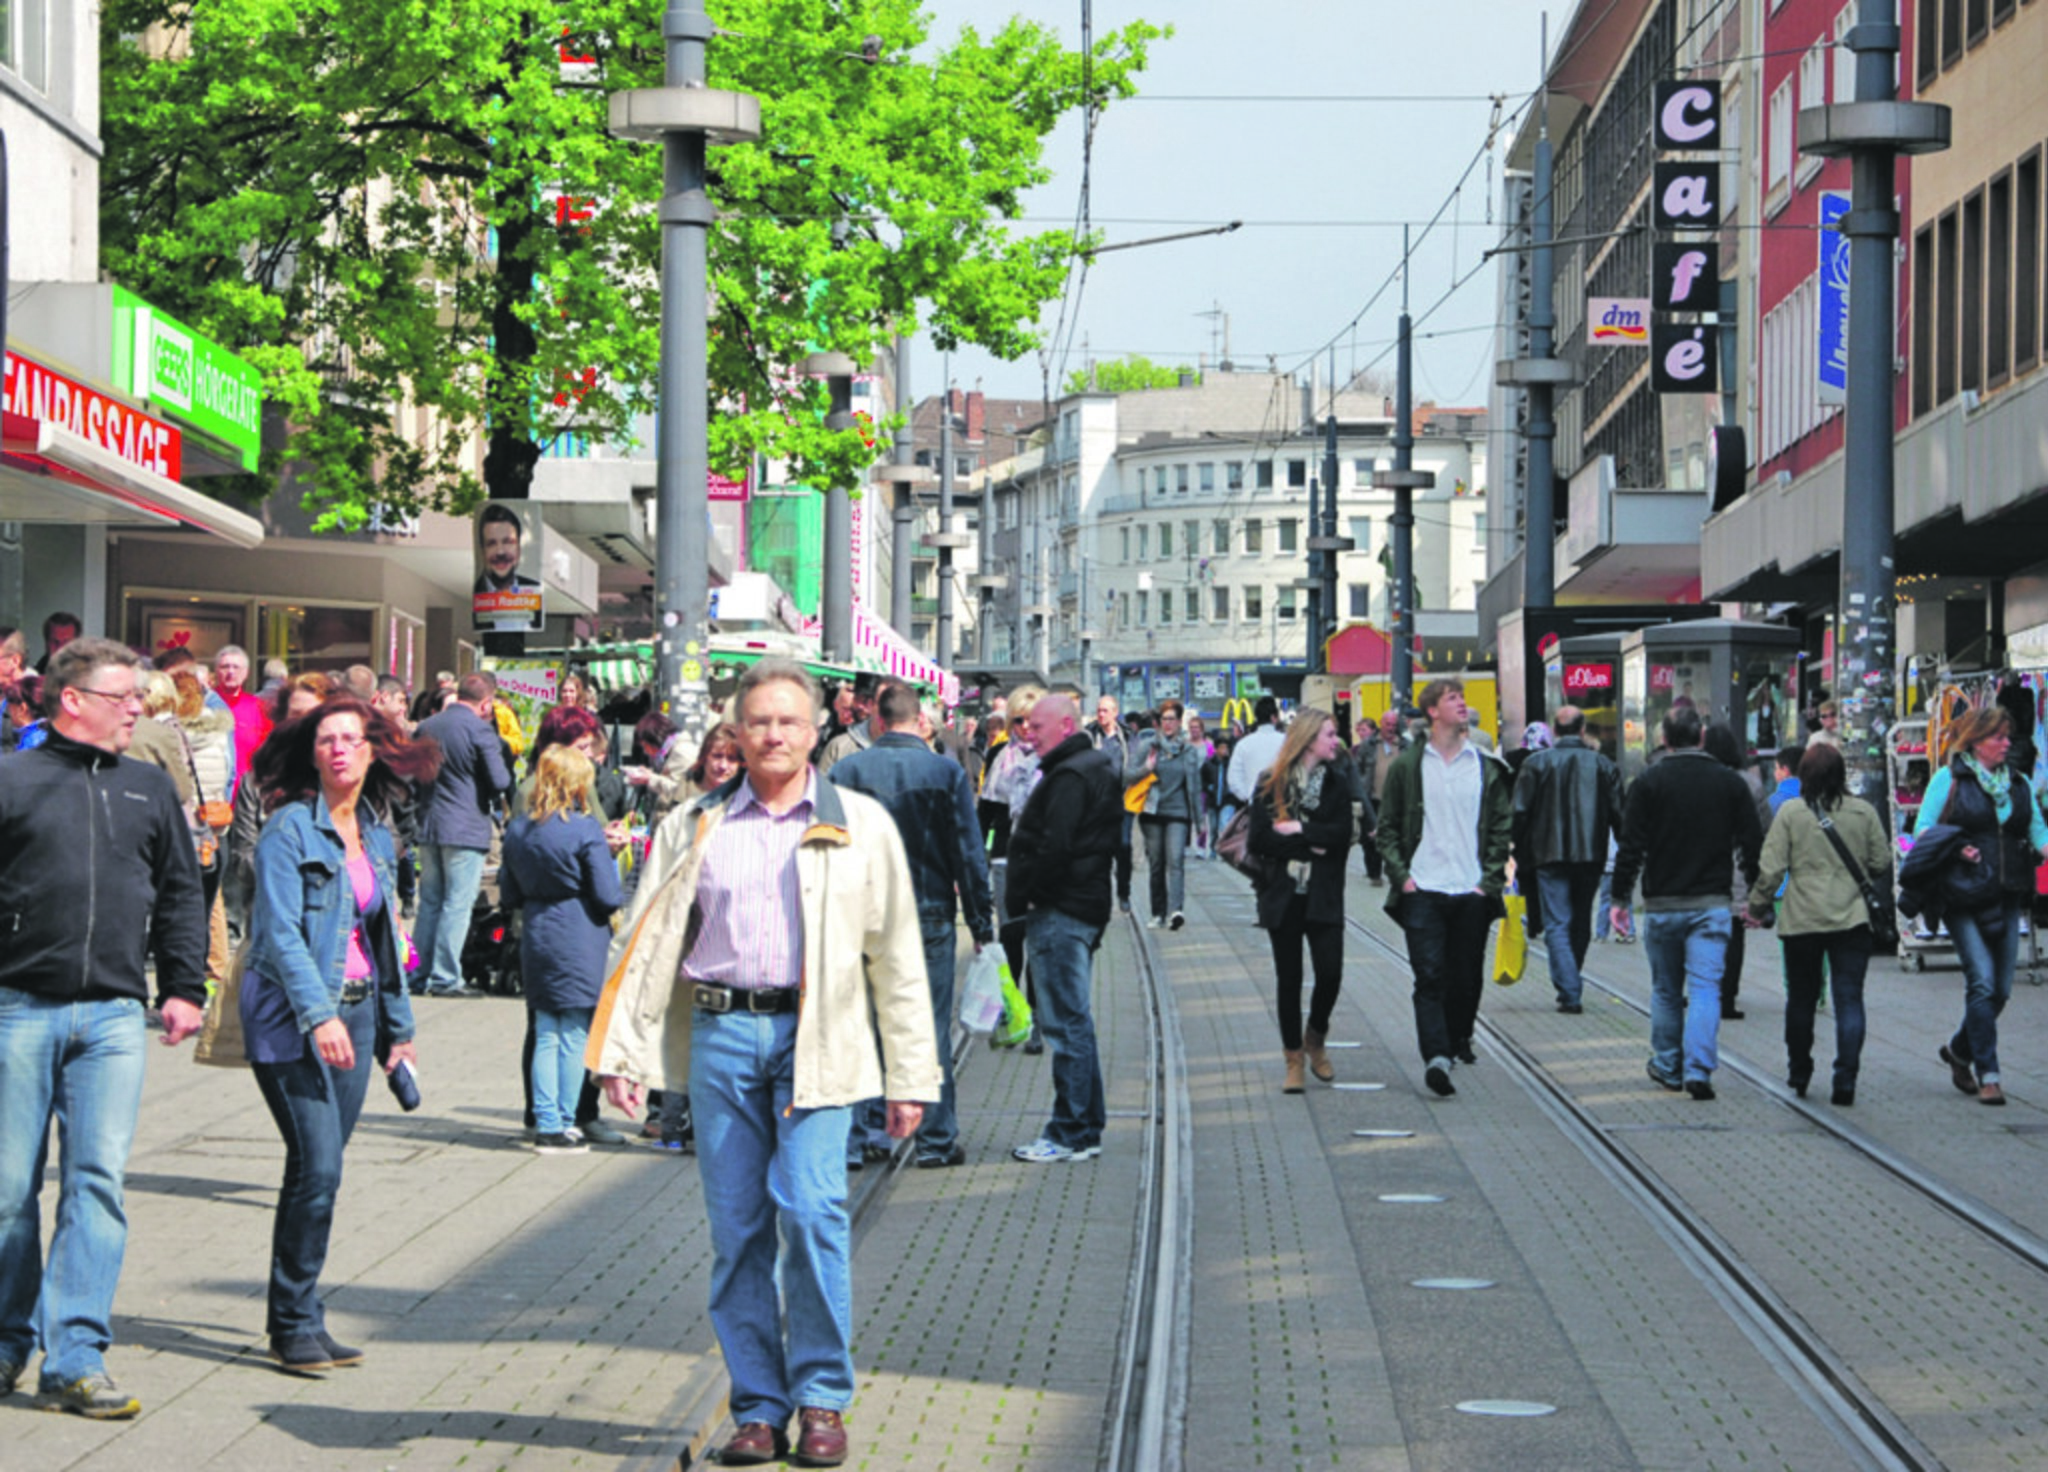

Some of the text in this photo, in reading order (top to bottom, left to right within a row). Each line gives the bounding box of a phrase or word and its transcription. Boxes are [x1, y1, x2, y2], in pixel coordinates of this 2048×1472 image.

[1659, 86, 1716, 381] Café
[1602, 304, 1641, 327] dm
[195, 352, 258, 433] HÖRGERÄTE
